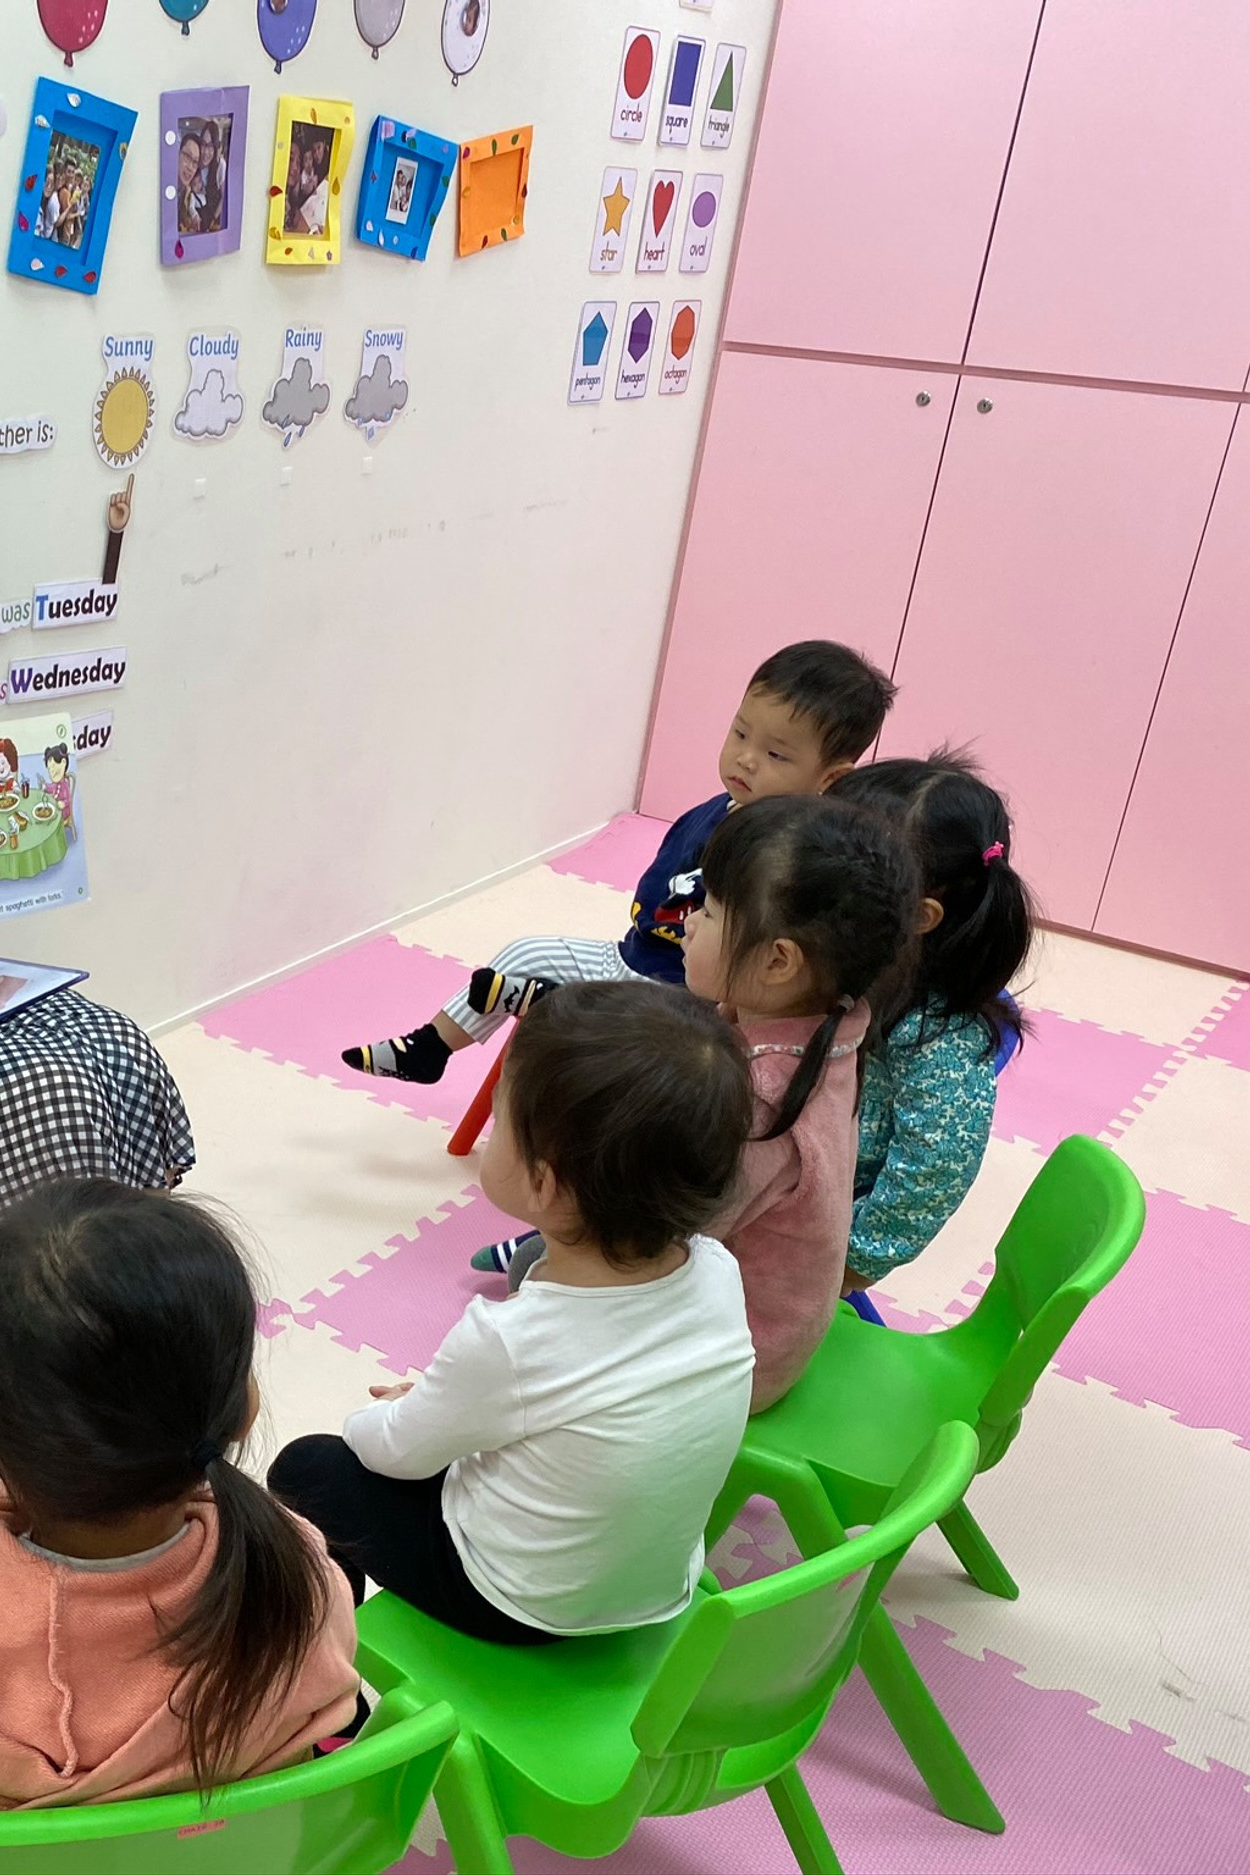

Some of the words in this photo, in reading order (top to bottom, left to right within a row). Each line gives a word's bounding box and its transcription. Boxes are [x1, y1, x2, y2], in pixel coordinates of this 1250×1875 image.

[619, 102, 643, 124] circle
[665, 114, 689, 135] square
[707, 114, 731, 139] triangle
[600, 240, 618, 261] star
[643, 240, 666, 261] heart
[689, 236, 708, 256] oval
[104, 335, 154, 362] Sunny
[189, 333, 240, 361] Cloudy
[285, 326, 323, 352] Rainy
[364, 329, 404, 351] Snowy
[574, 372, 601, 391] pentagon
[620, 369, 646, 389] hexagon
[663, 364, 688, 384] octagon
[37, 419, 54, 443] is:
[1, 601, 31, 624] was
[35, 588, 118, 622] Tuesday
[10, 657, 127, 695] Wednesday
